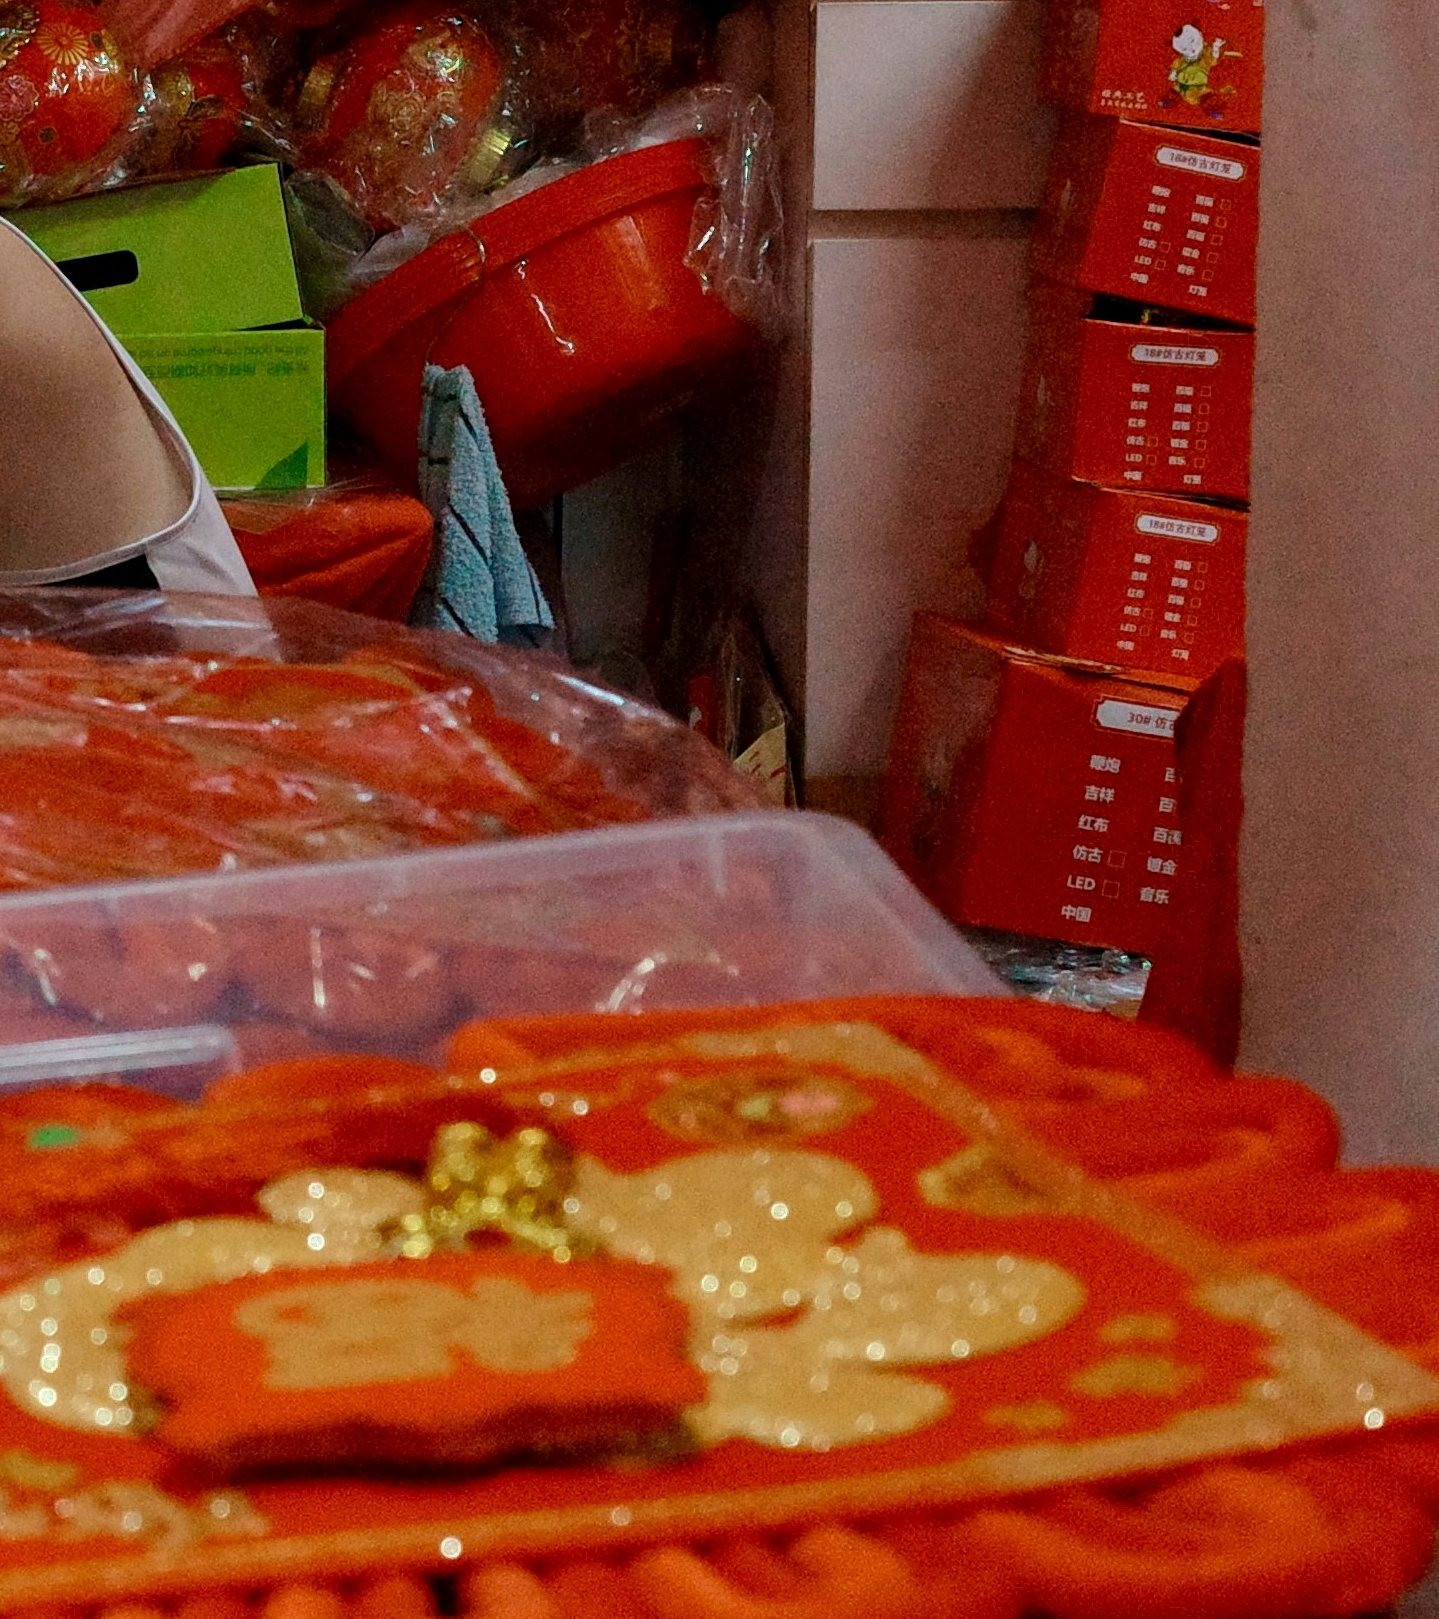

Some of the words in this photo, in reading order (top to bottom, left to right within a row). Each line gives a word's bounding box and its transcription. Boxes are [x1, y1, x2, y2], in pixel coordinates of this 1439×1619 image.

[1084, 784, 1116, 803] 吉祥
[1077, 814, 1110, 833] 红布
[1072, 844, 1104, 863] 仿古
[1066, 874, 1096, 891] LED
[1139, 886, 1170, 905] 音乐
[1061, 904, 1092, 923] 中国
